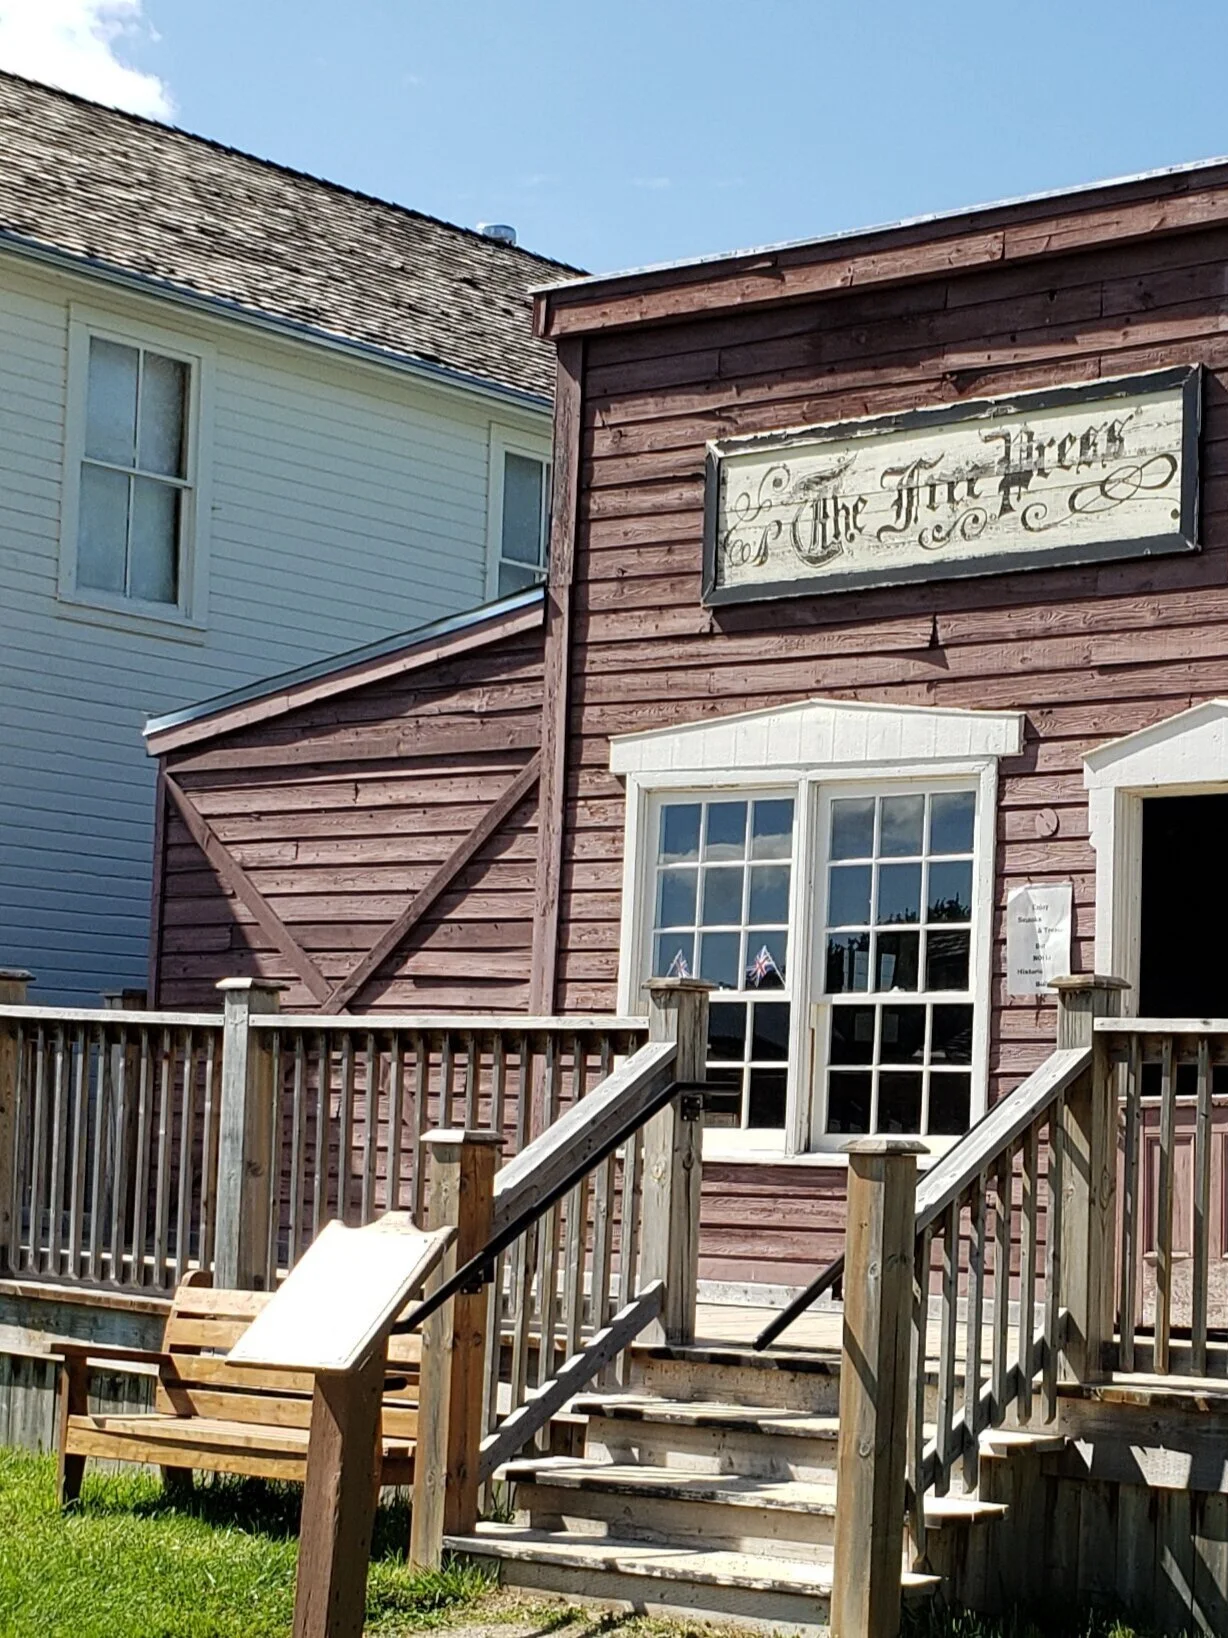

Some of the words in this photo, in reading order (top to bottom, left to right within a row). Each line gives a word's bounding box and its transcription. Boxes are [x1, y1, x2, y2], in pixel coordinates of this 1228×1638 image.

[790, 452, 868, 568] The
[876, 452, 984, 542] Free
[978, 414, 1134, 520] Press
